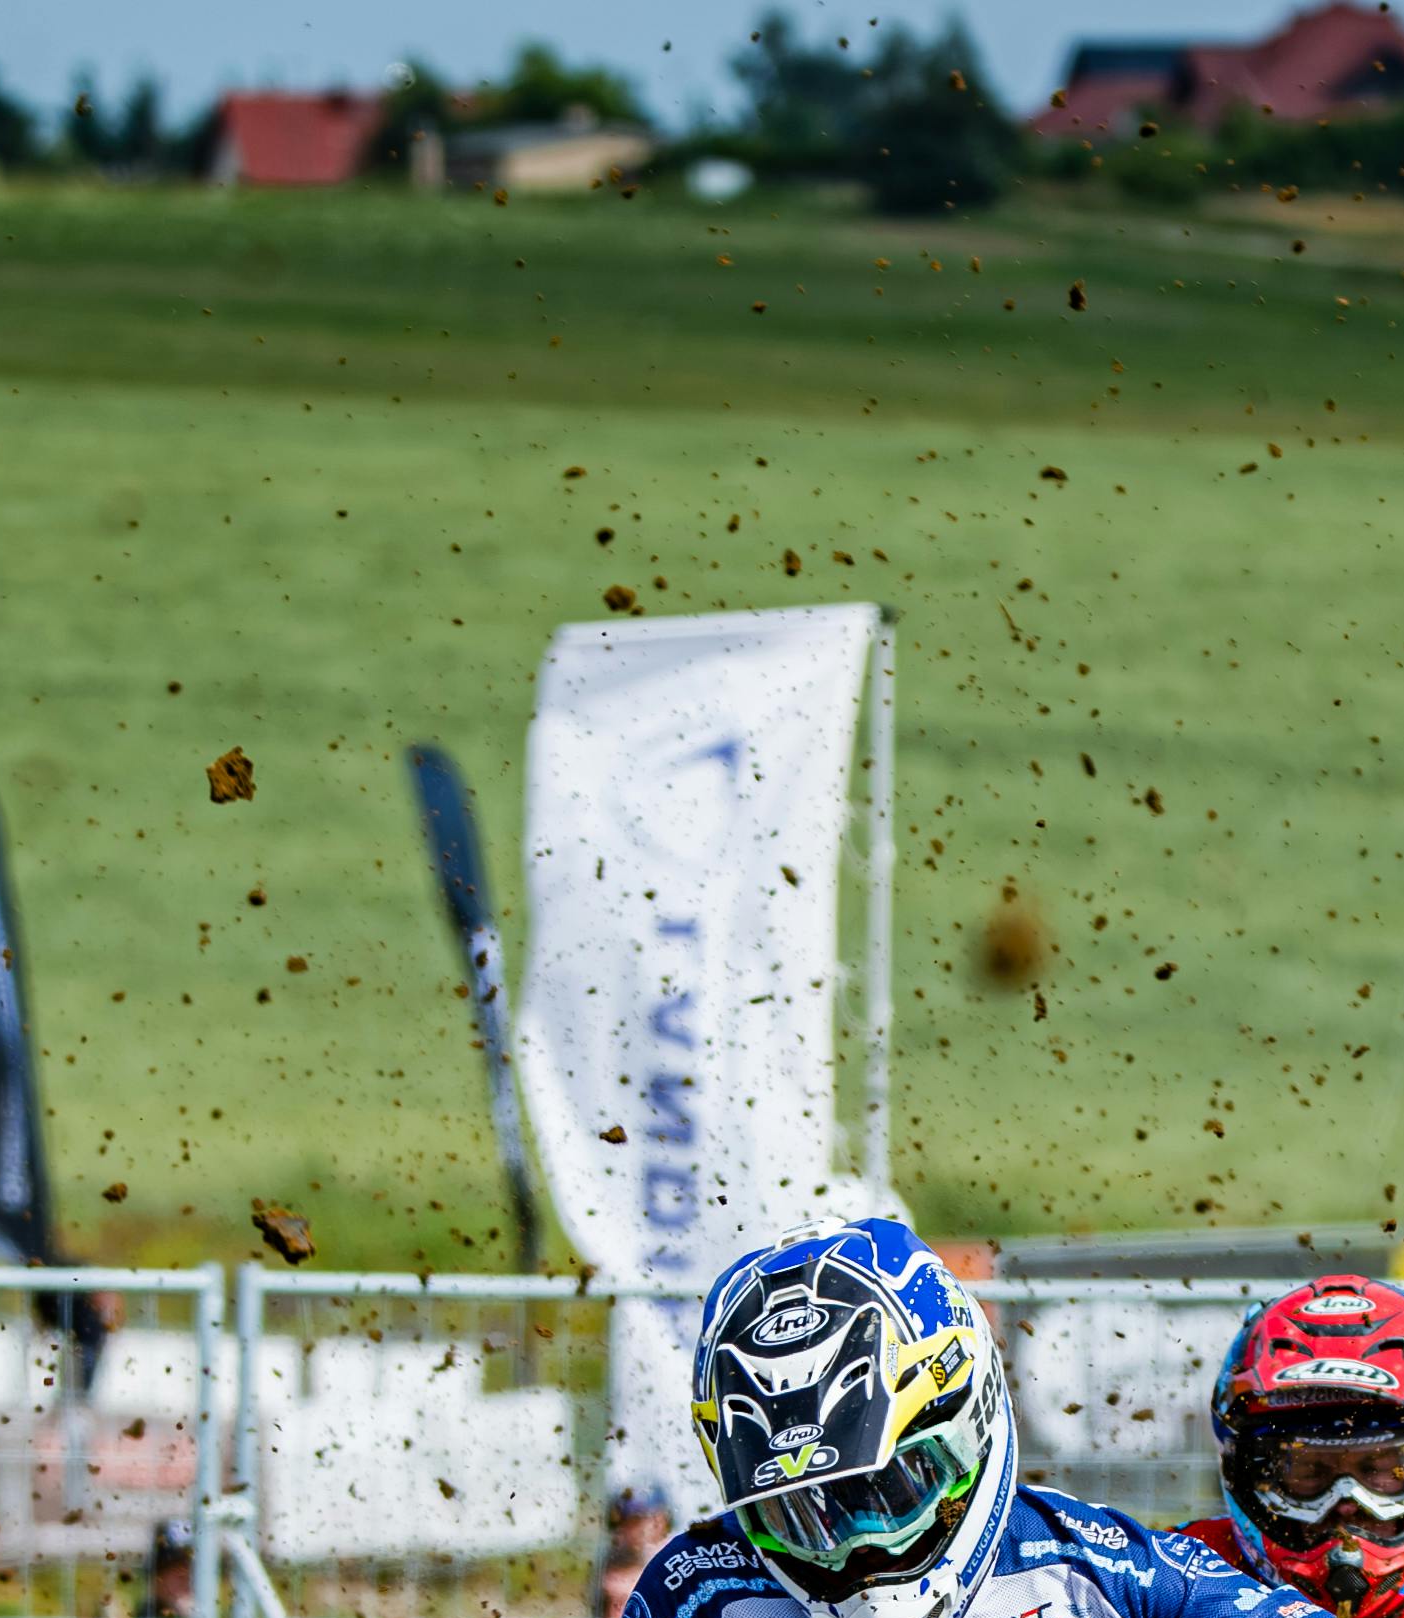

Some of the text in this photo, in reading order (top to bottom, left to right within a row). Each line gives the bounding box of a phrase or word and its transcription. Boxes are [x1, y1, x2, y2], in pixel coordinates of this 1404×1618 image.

[754, 1442, 840, 1487] SVO
[663, 1541, 743, 1573] RLMX
[663, 1554, 760, 1591] DESIGN
